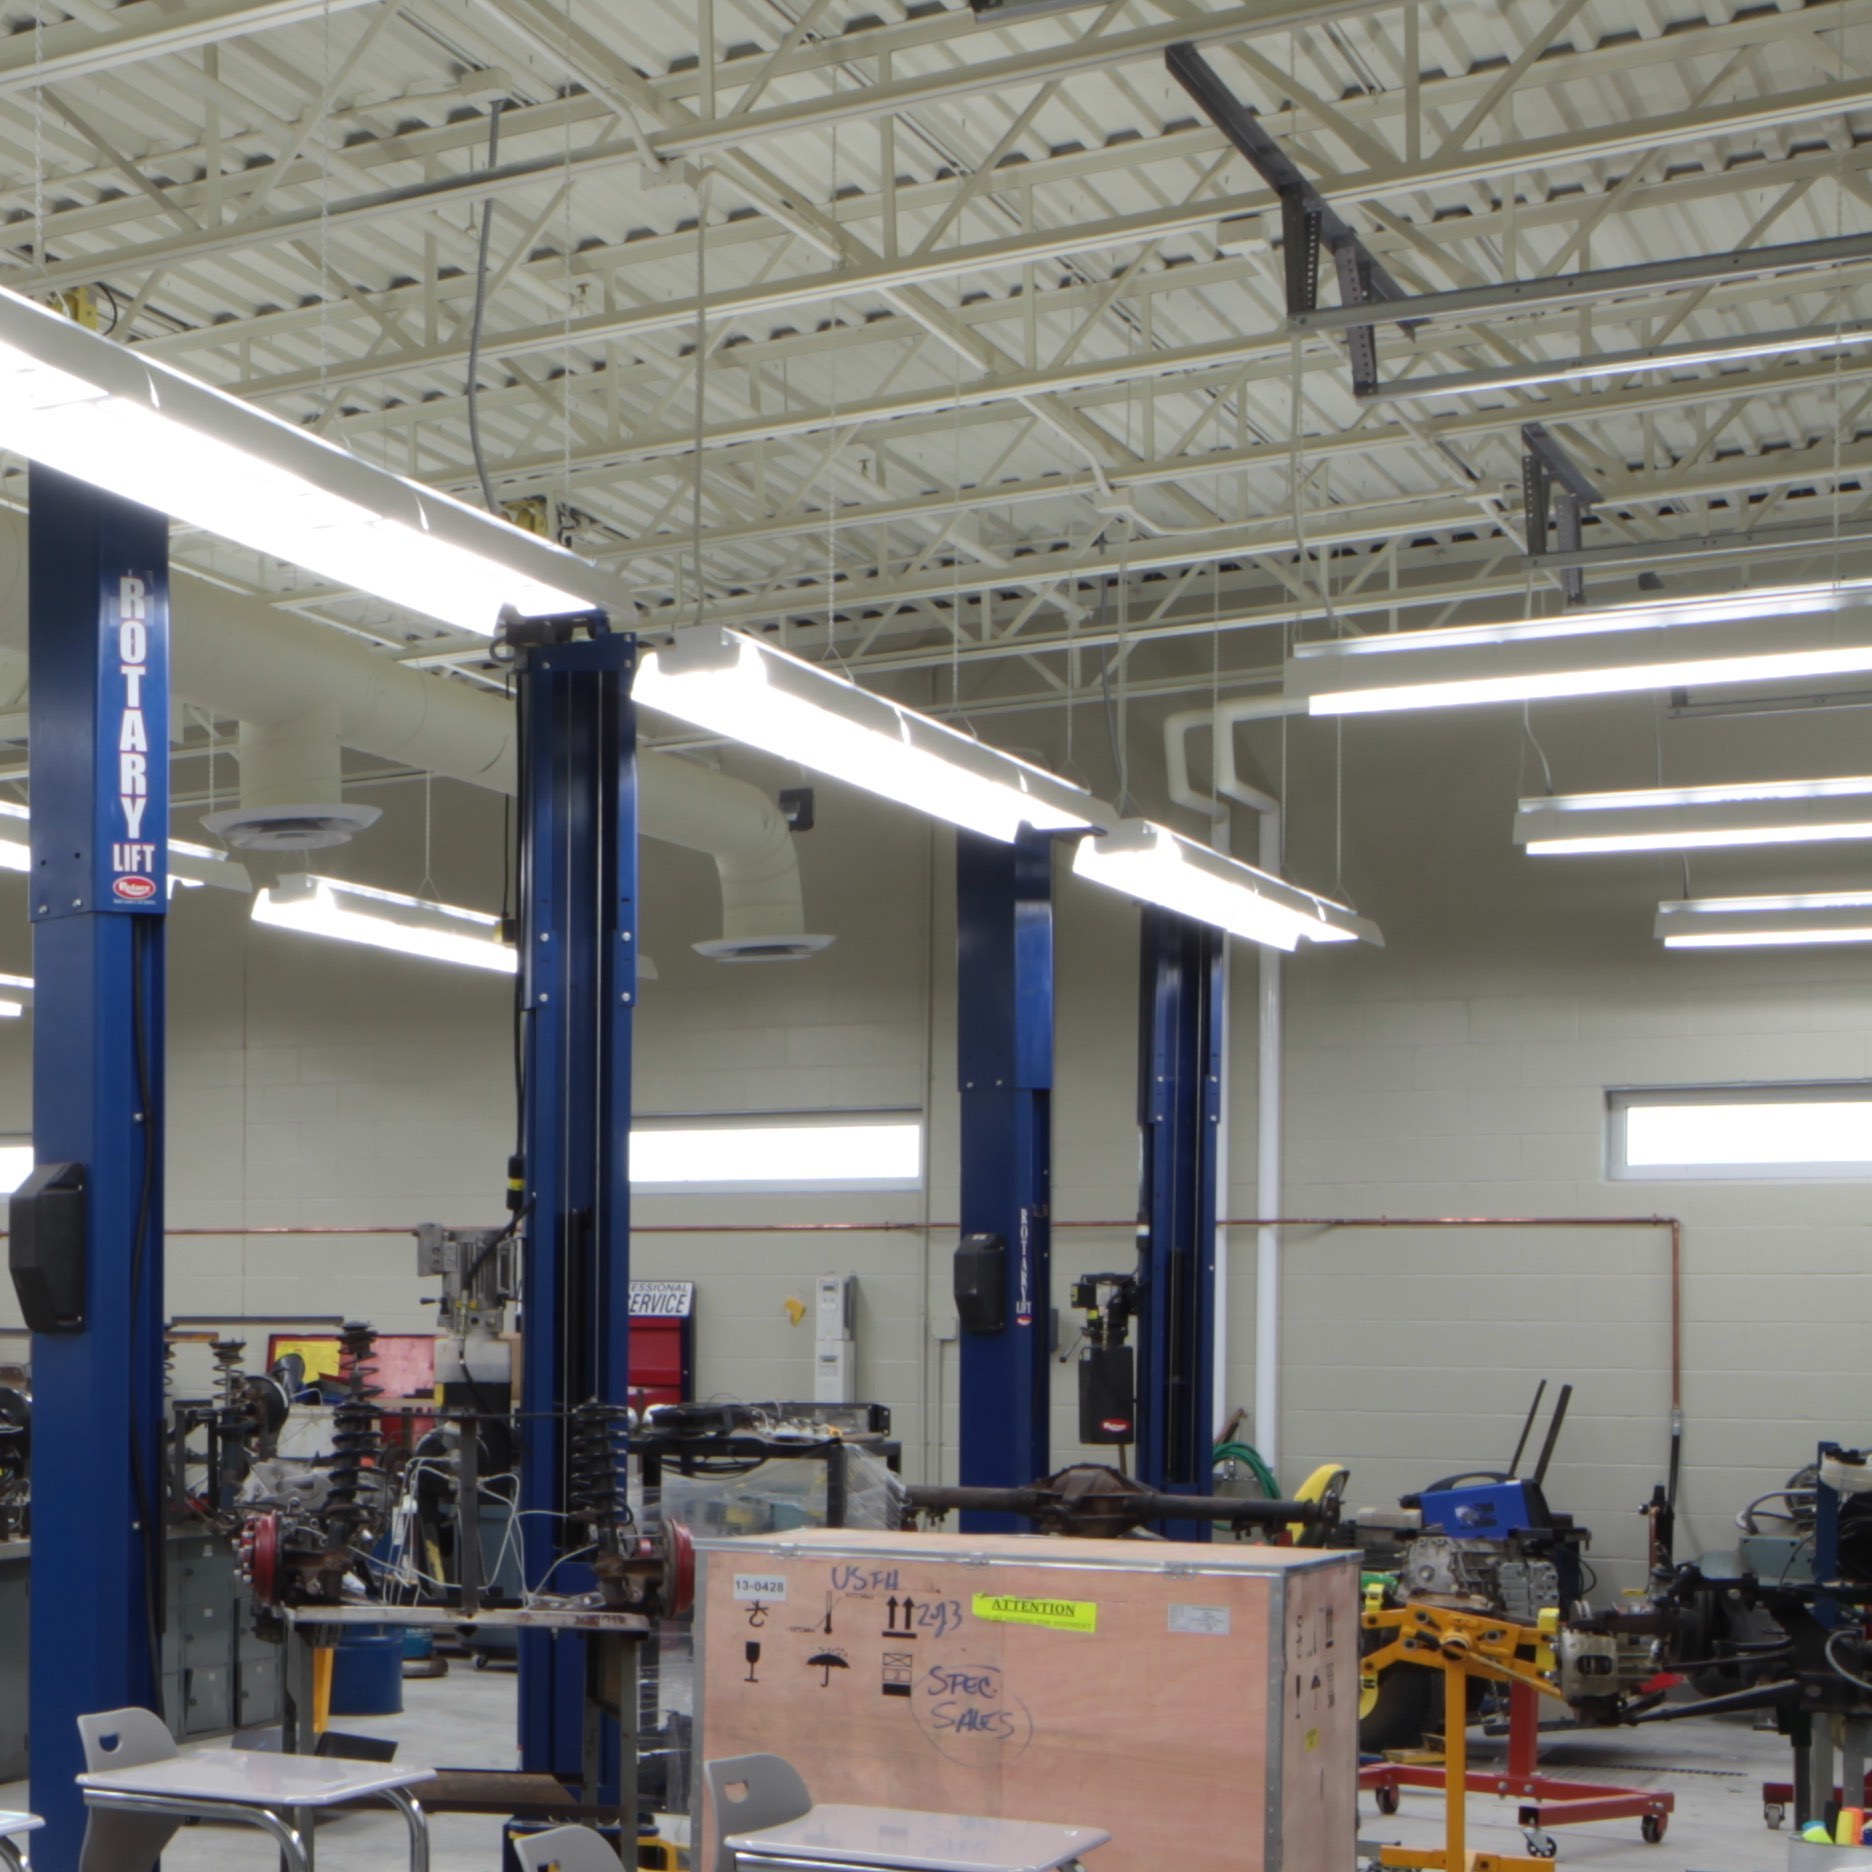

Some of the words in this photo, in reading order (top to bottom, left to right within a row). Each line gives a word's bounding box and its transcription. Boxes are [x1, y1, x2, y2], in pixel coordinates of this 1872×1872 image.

[119, 576, 148, 839] ROTARY
[113, 844, 155, 873] LIFT
[1020, 1207, 1028, 1301] ROTARY
[629, 1293, 687, 1313] ERVICE
[736, 1580, 784, 1592] 13-0428
[992, 1599, 1076, 1616] ATTENTION
